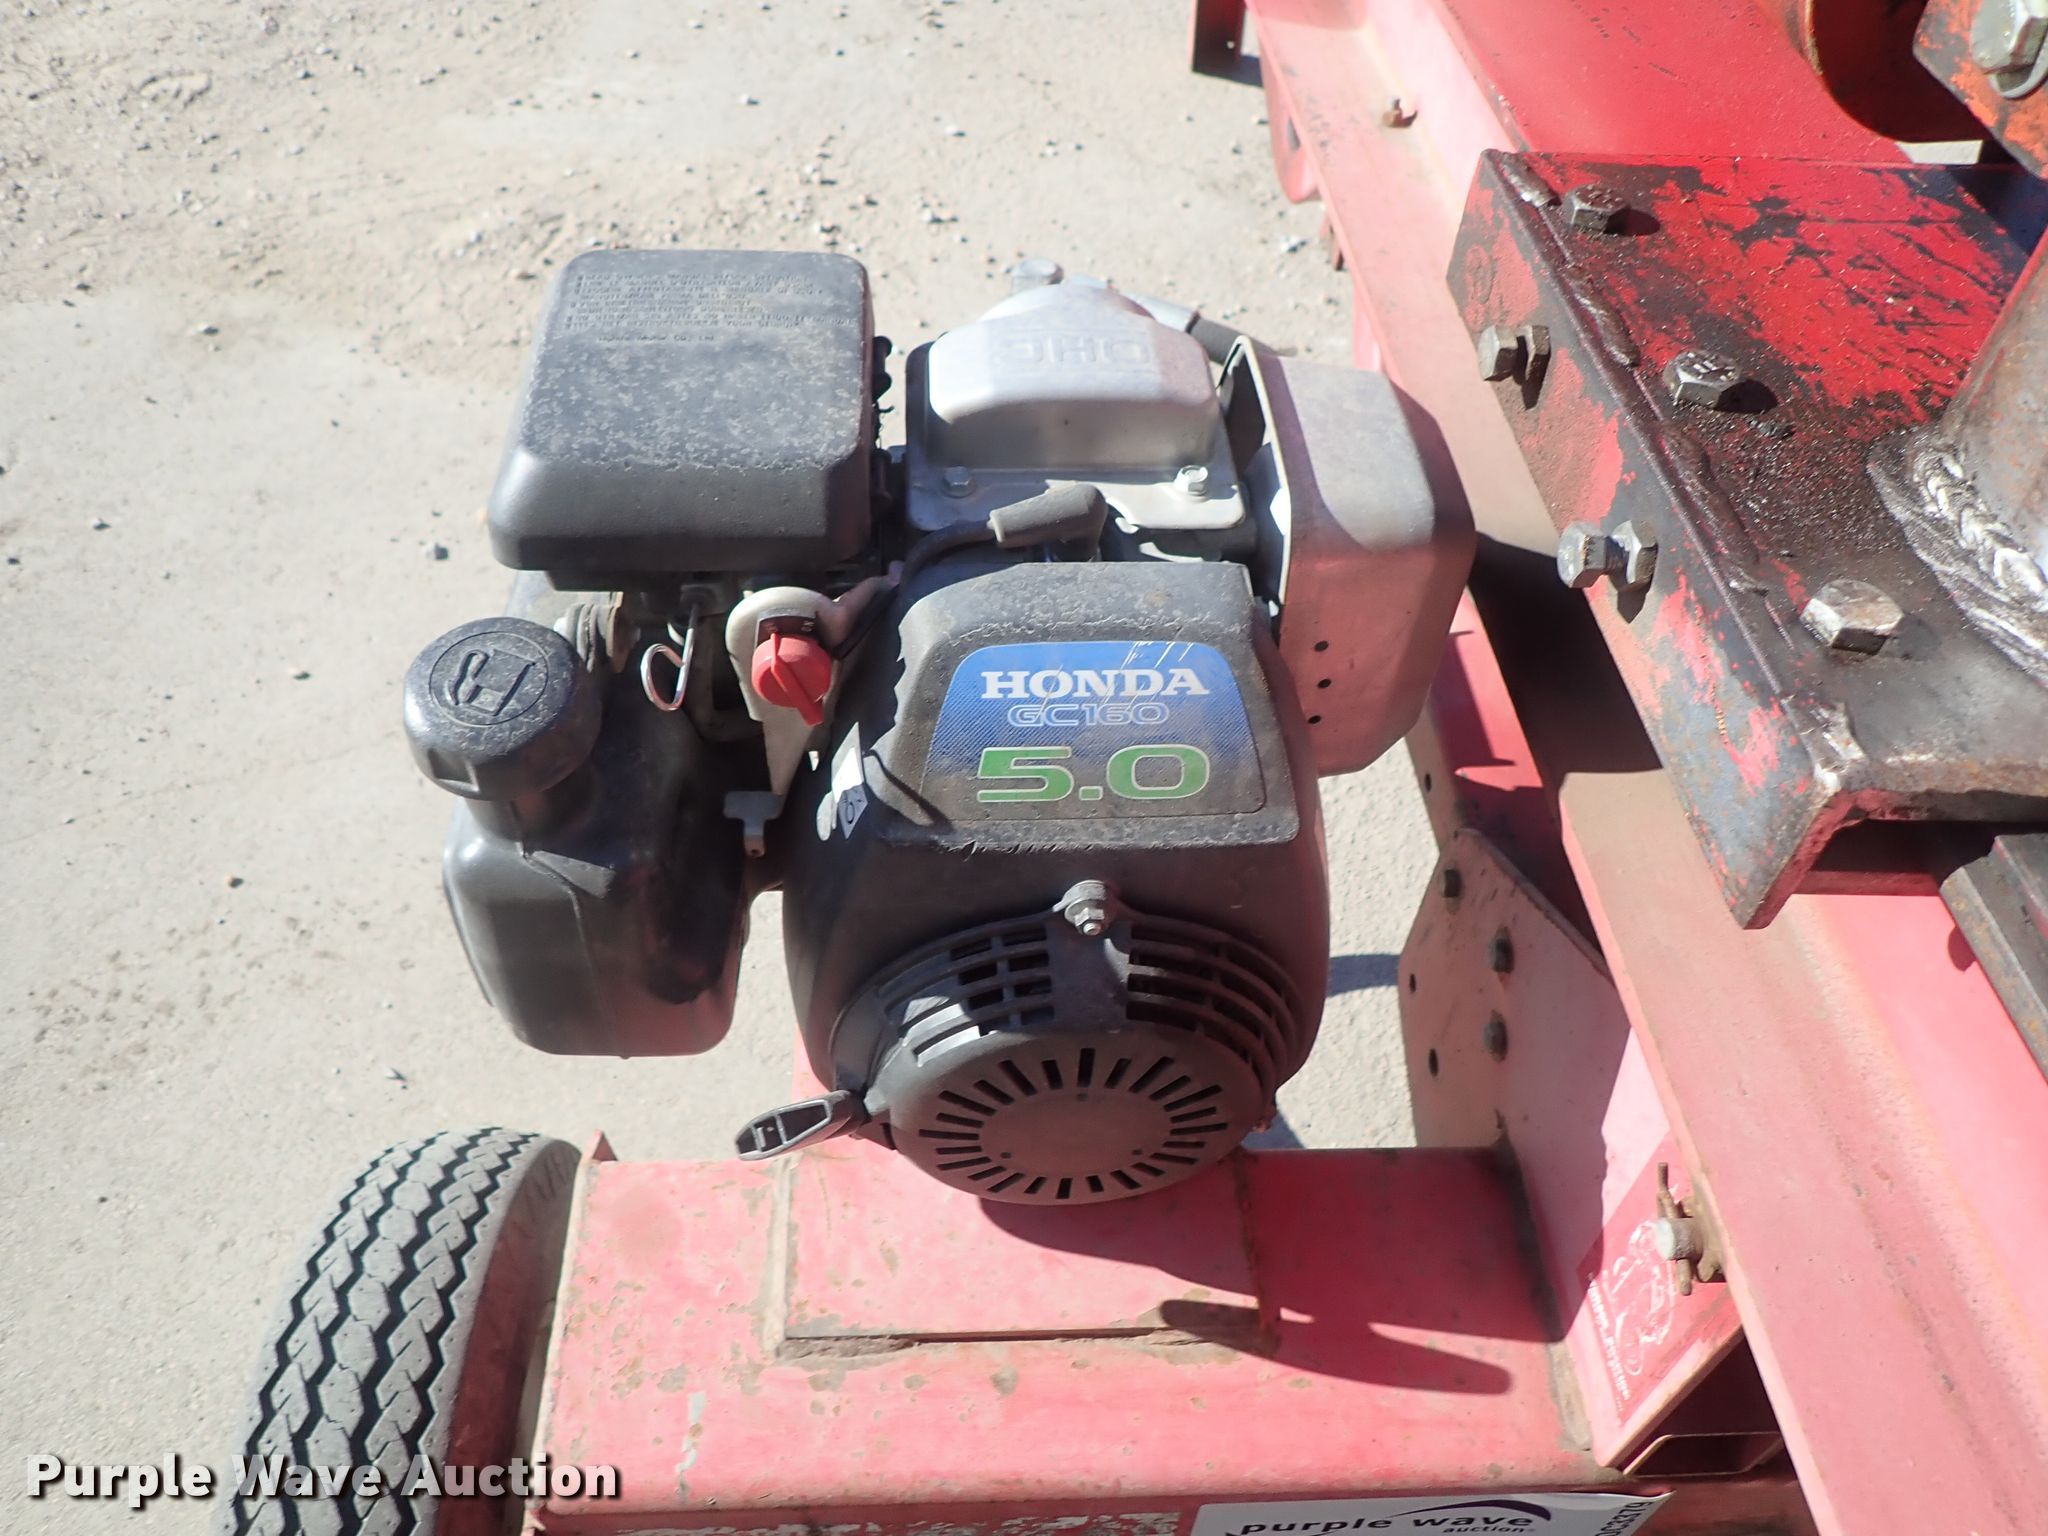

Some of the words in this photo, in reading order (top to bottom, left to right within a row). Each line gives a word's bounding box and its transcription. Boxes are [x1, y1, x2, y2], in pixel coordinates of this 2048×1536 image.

[980, 668, 1210, 699] HONDA
[1007, 703, 1170, 727] GC160
[976, 743, 1211, 803] 5.0
[1240, 1518, 1393, 1535] purple
[1413, 1516, 1534, 1527] wave
[1443, 1525, 1525, 1534] auction
